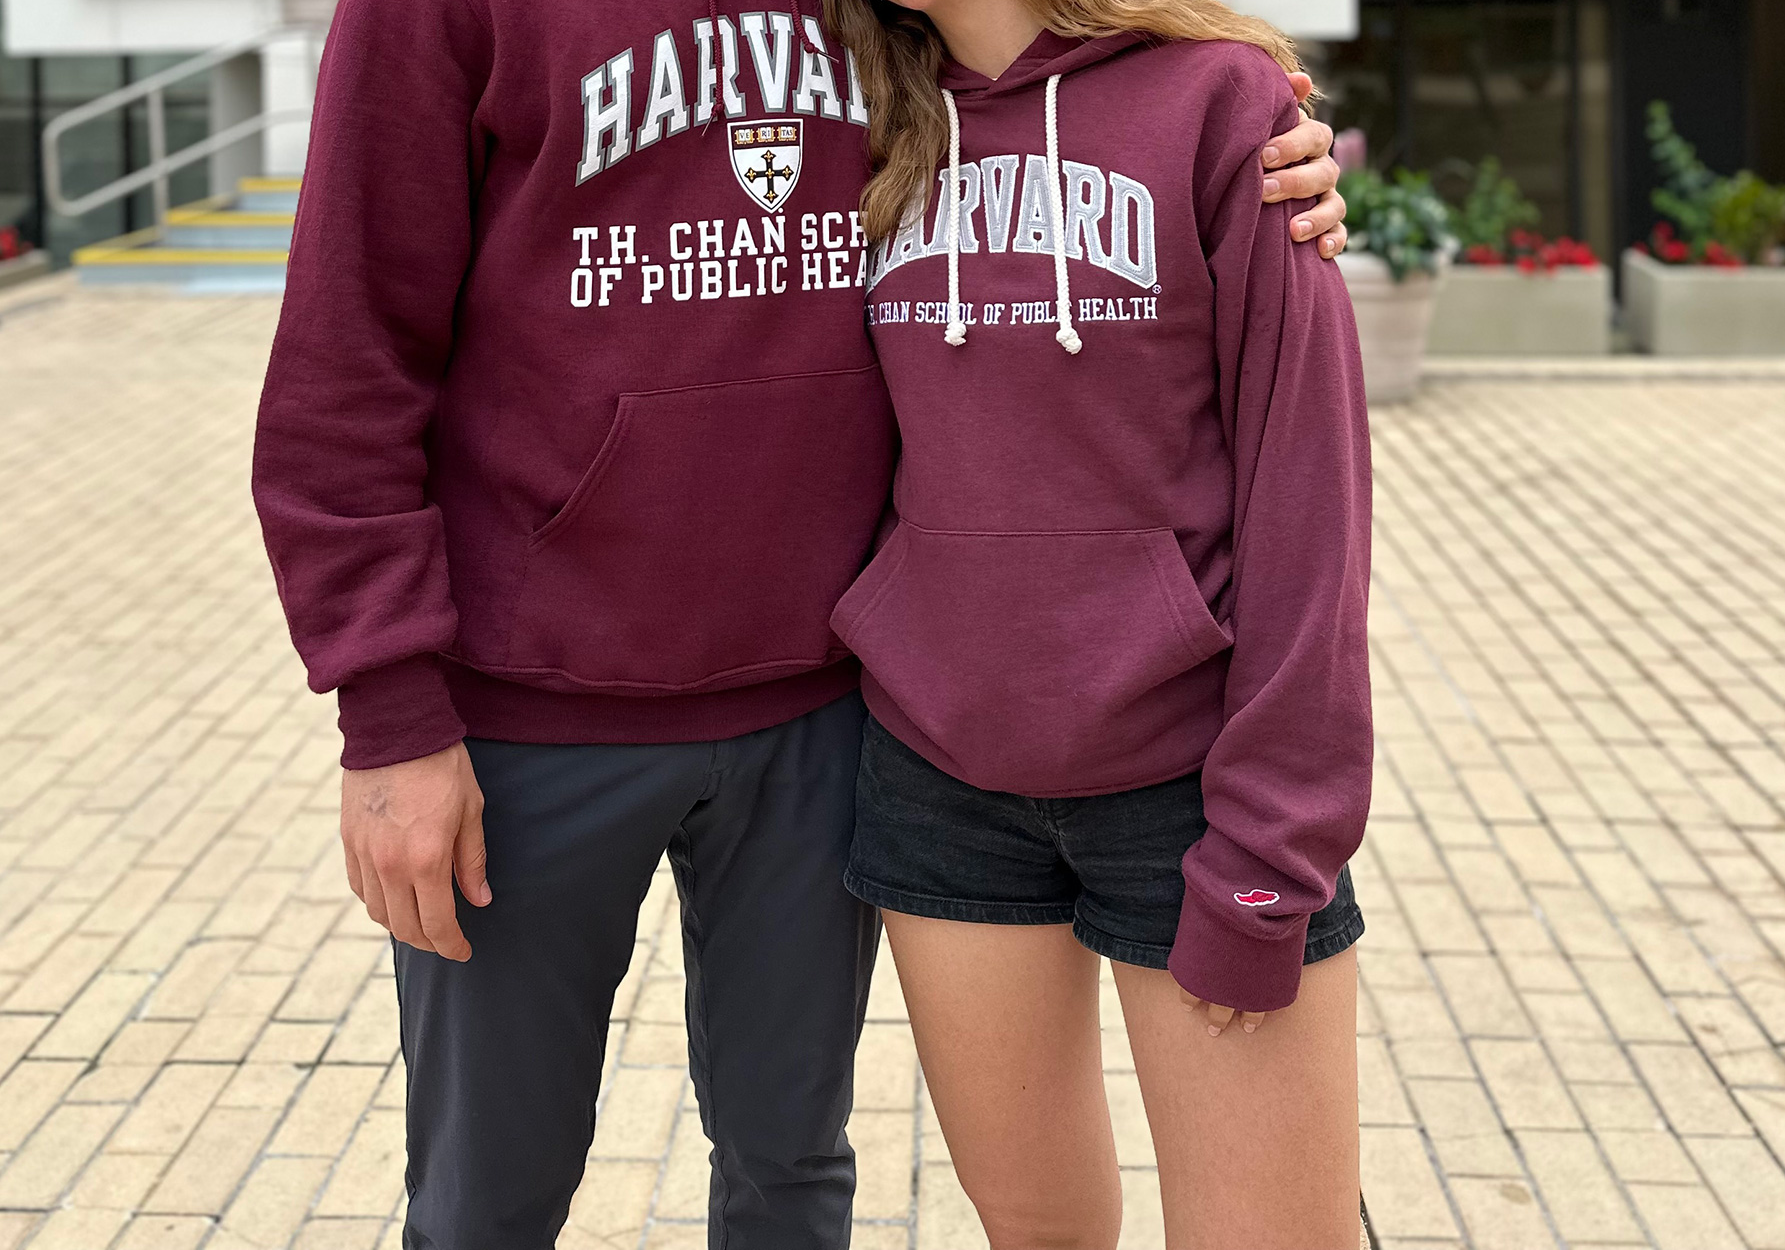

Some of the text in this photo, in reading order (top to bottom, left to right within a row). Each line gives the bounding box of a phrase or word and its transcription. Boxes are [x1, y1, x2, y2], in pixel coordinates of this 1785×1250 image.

[572, 225, 650, 266] T.H.
[669, 215, 787, 261] CHAN
[570, 267, 623, 308] OF
[641, 256, 788, 304] PUBLIC
[879, 301, 911, 324] CHAN
[983, 302, 1006, 325] OF
[1078, 297, 1158, 321] HEALTH
